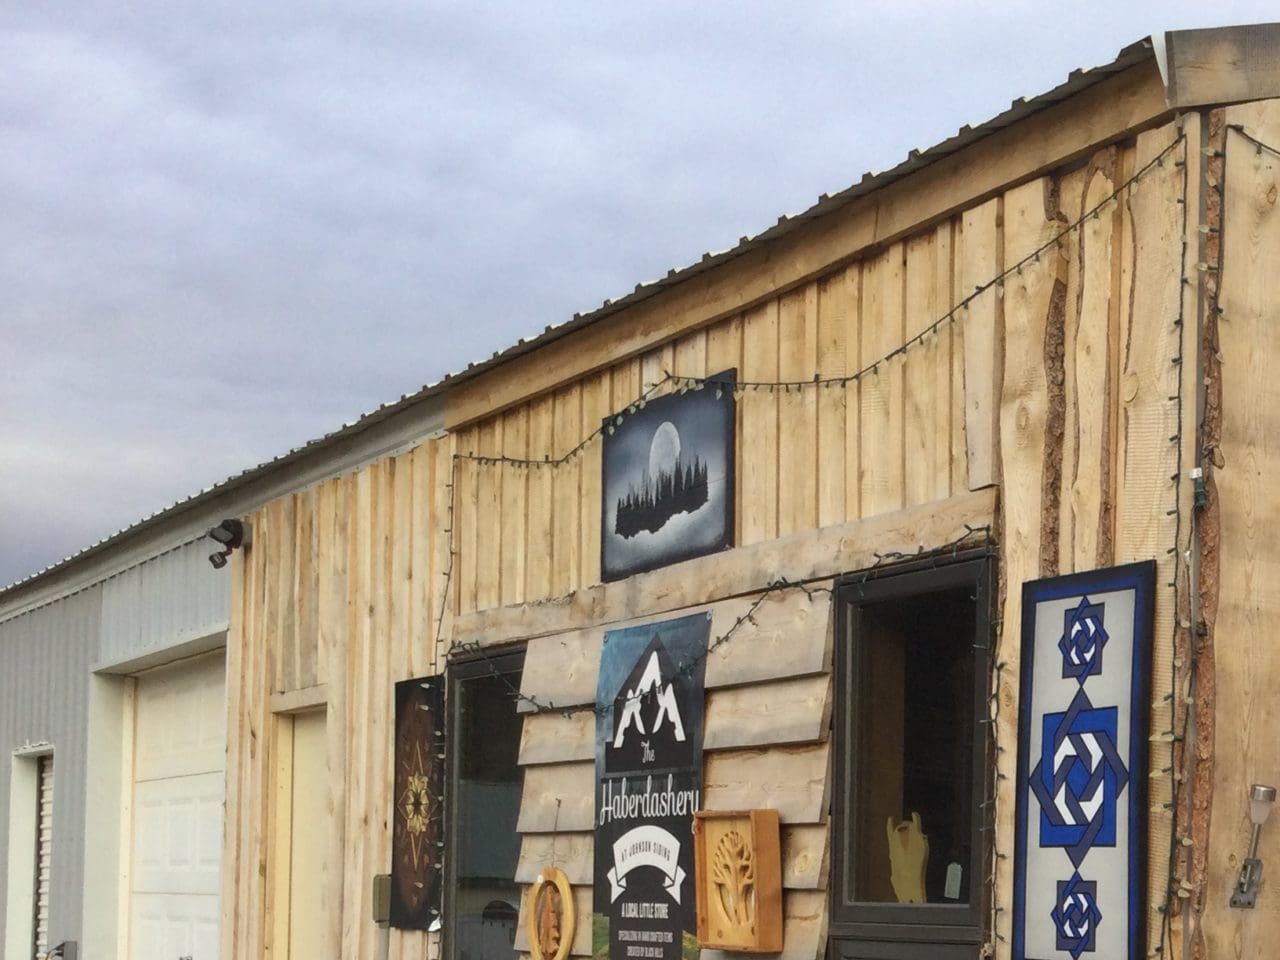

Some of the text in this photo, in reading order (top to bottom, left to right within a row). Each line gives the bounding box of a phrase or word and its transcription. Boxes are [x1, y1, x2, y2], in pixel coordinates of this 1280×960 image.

[641, 740, 655, 763] The
[600, 773, 699, 834] Haberdashery
[621, 841, 671, 862] AT JOHNSON SIDING
